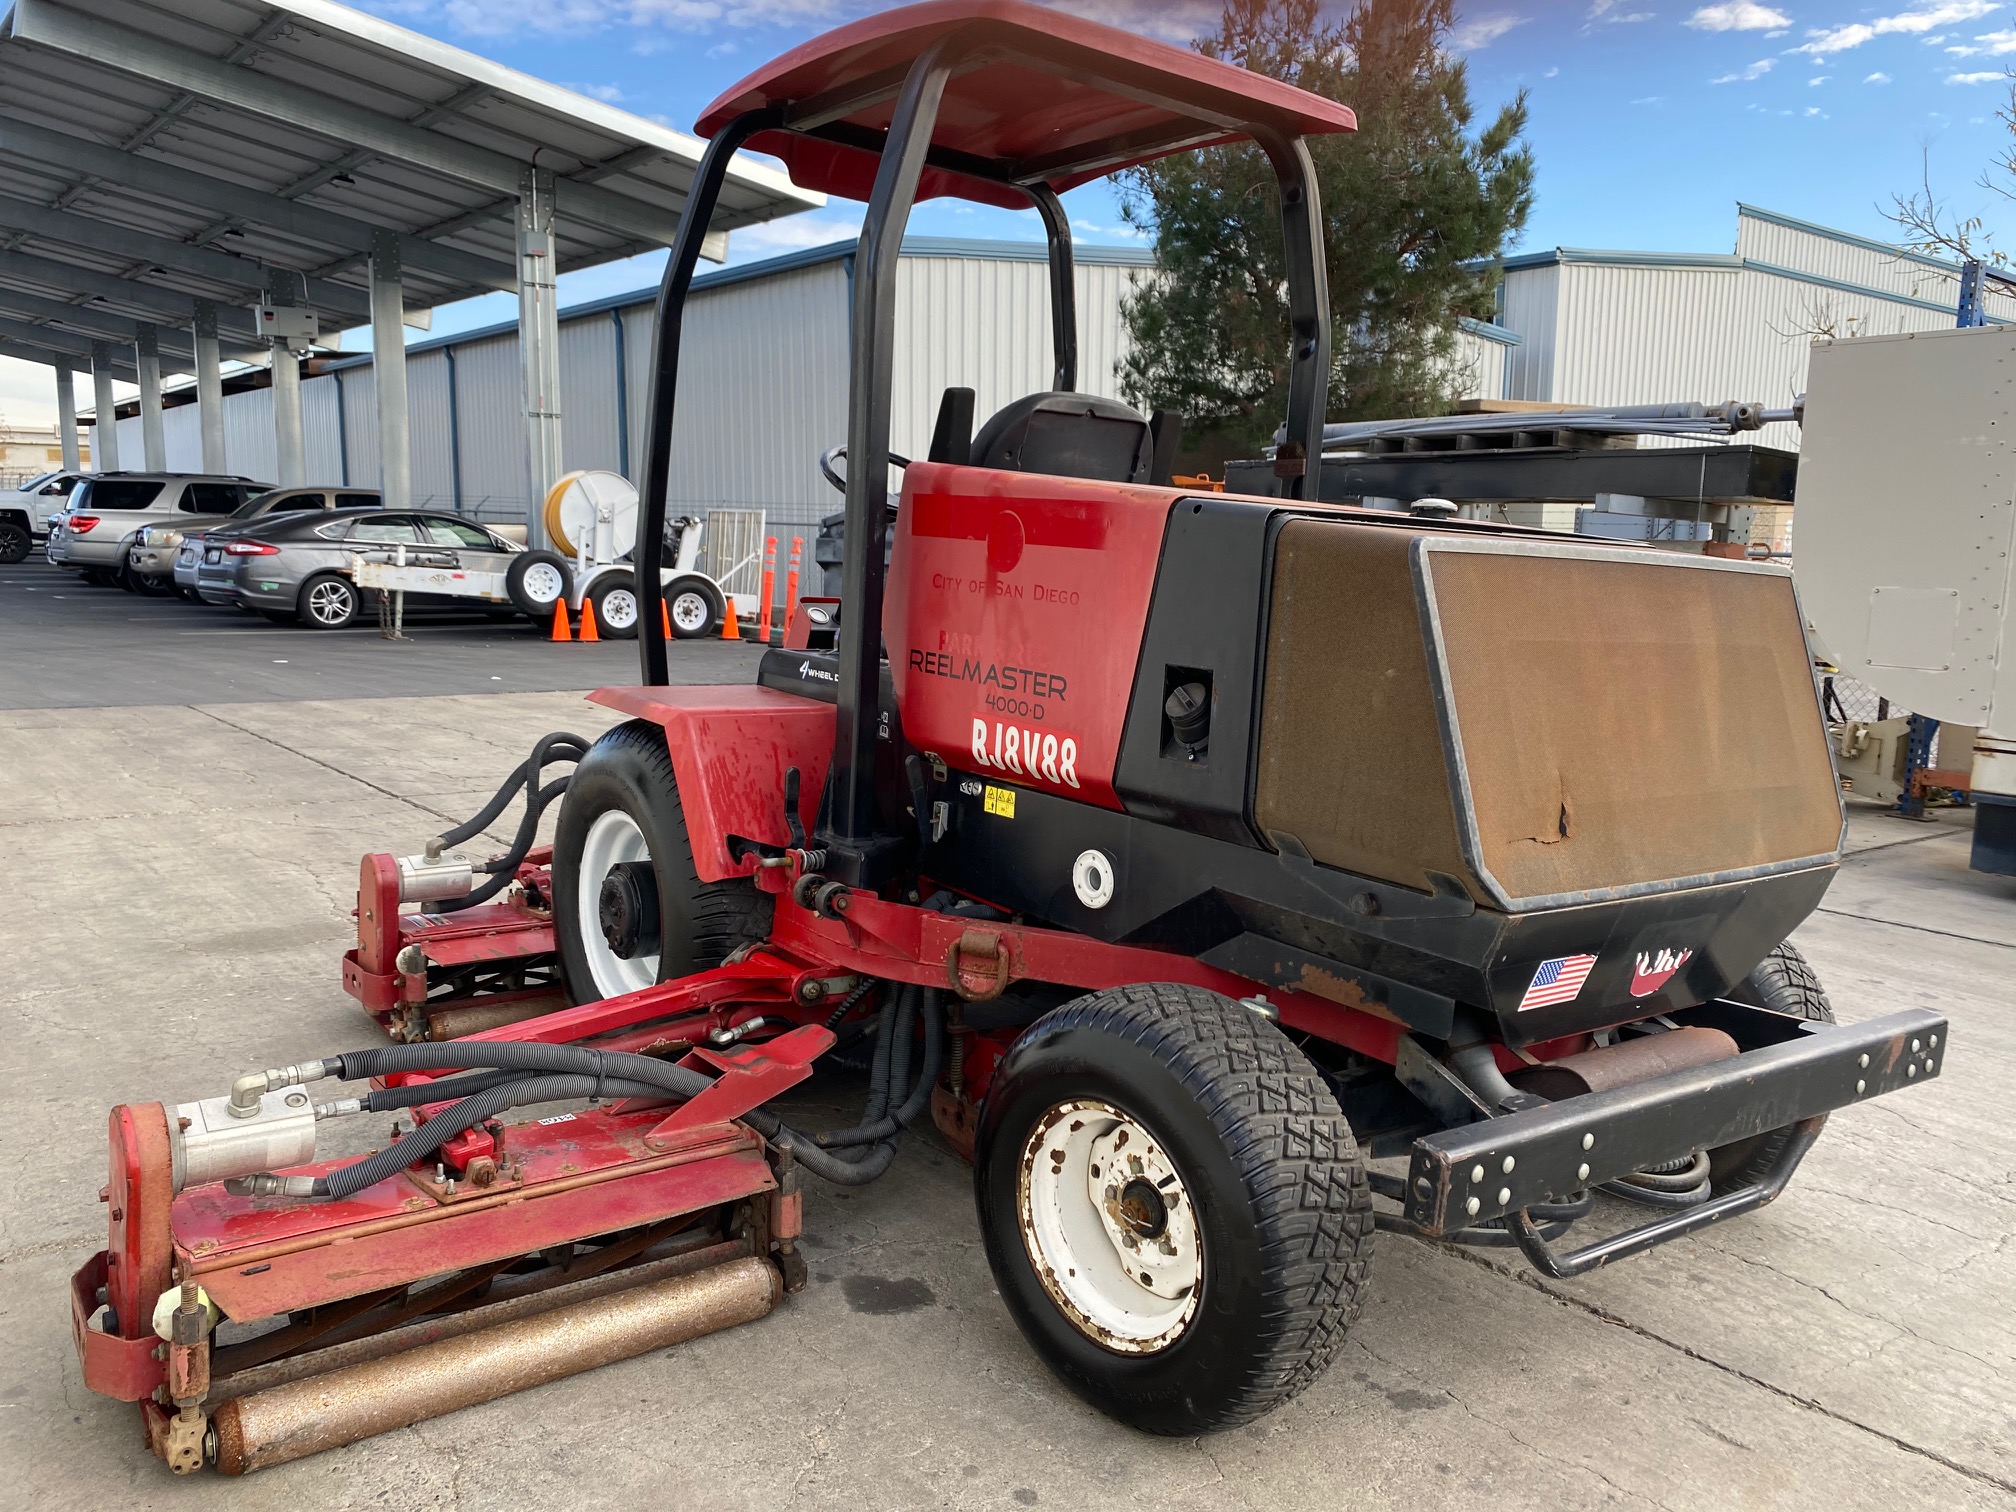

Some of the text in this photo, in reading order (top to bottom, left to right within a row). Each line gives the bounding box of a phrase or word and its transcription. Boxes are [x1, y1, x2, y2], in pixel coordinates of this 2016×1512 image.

[932, 573, 1080, 606] CITY OF SAN DIEGO
[910, 648, 1068, 701] REELMASTER
[972, 718, 1080, 788] BJ8V88
